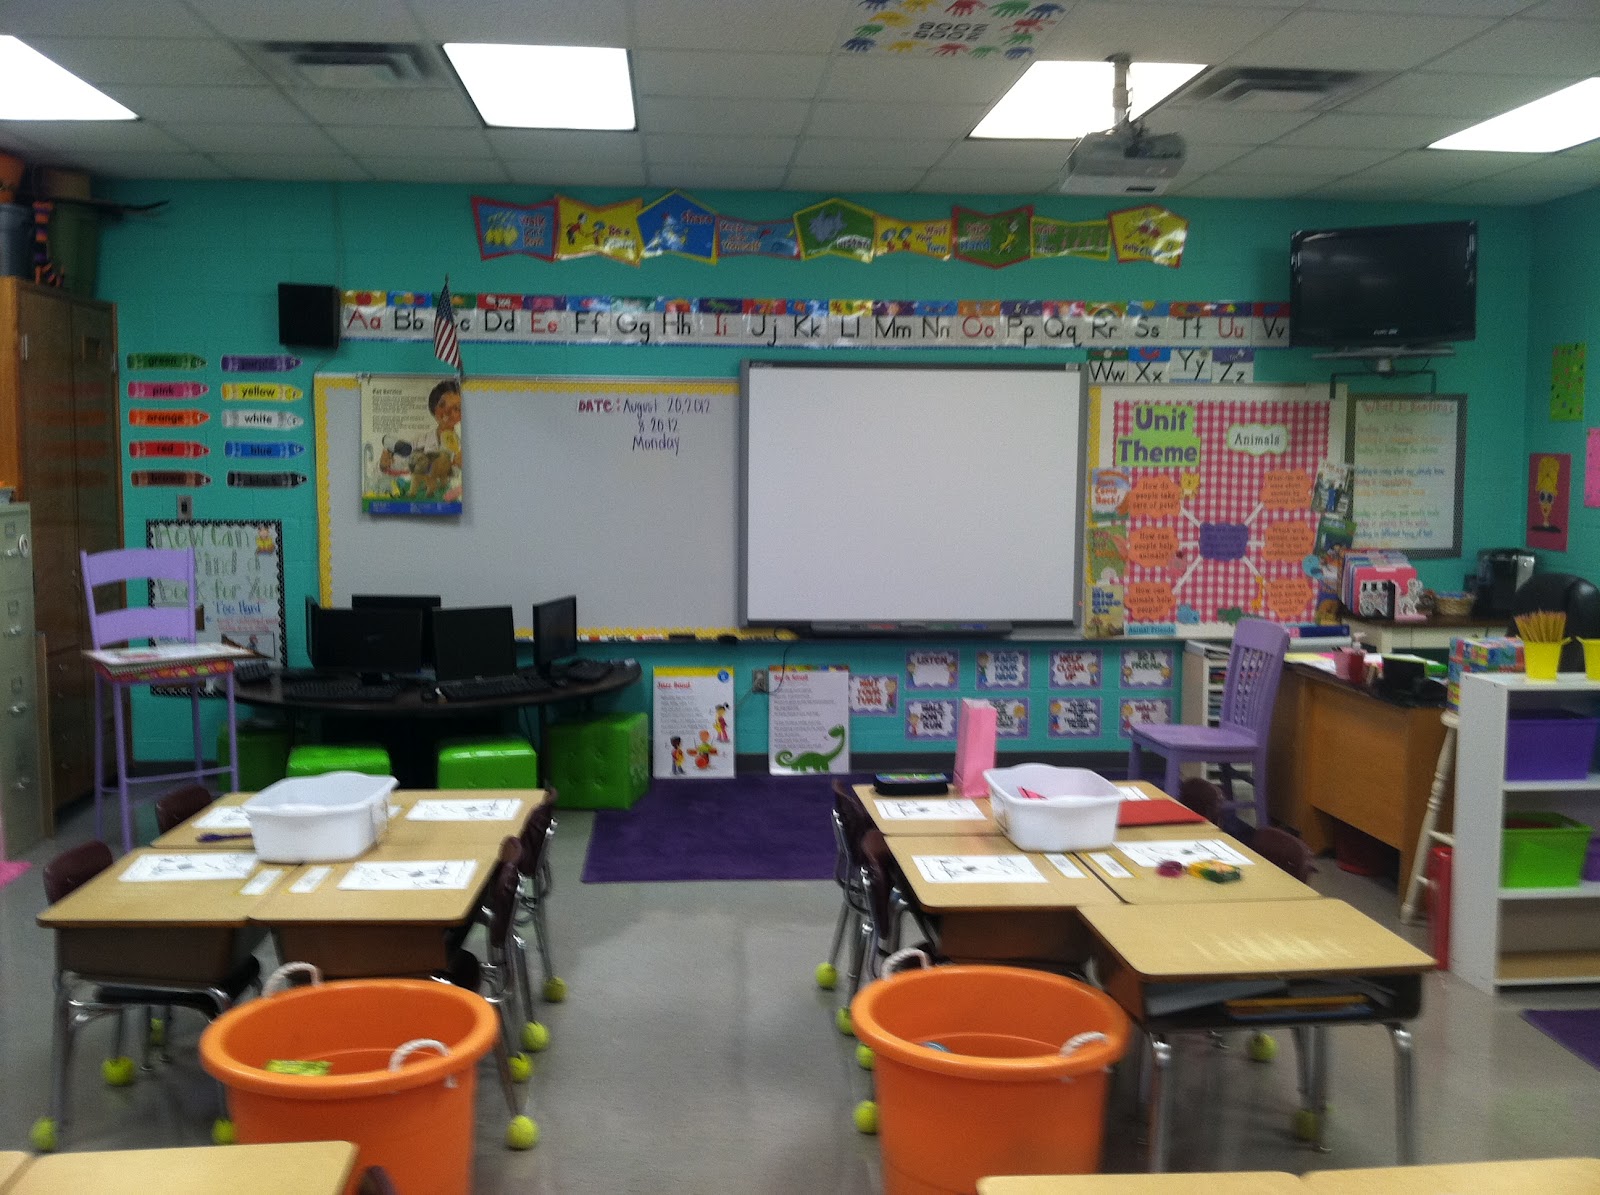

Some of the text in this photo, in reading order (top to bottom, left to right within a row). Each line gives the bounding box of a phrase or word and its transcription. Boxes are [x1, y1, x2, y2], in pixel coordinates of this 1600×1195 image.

[346, 307, 1285, 348] Aa Bb c Dd Ee Ff Gg Hh Ii Jj Kk Ll Mm Nn Oo Pp Qq Rr Ss Tt Uu Vv
[147, 355, 178, 367] green
[1088, 349, 1246, 383] Ww Xx Yy Zz
[152, 384, 175, 397] pink
[242, 386, 276, 399] yellow
[623, 397, 657, 420] August
[147, 412, 185, 425] orange
[244, 411, 273, 423] white
[1135, 406, 1188, 432] Unit
[632, 432, 680, 457] Monday
[1233, 432, 1281, 448] Animals
[156, 443, 175, 453] red
[250, 445, 273, 456] blue
[1117, 437, 1198, 463] Theme
[916, 655, 949, 666] LISTEN
